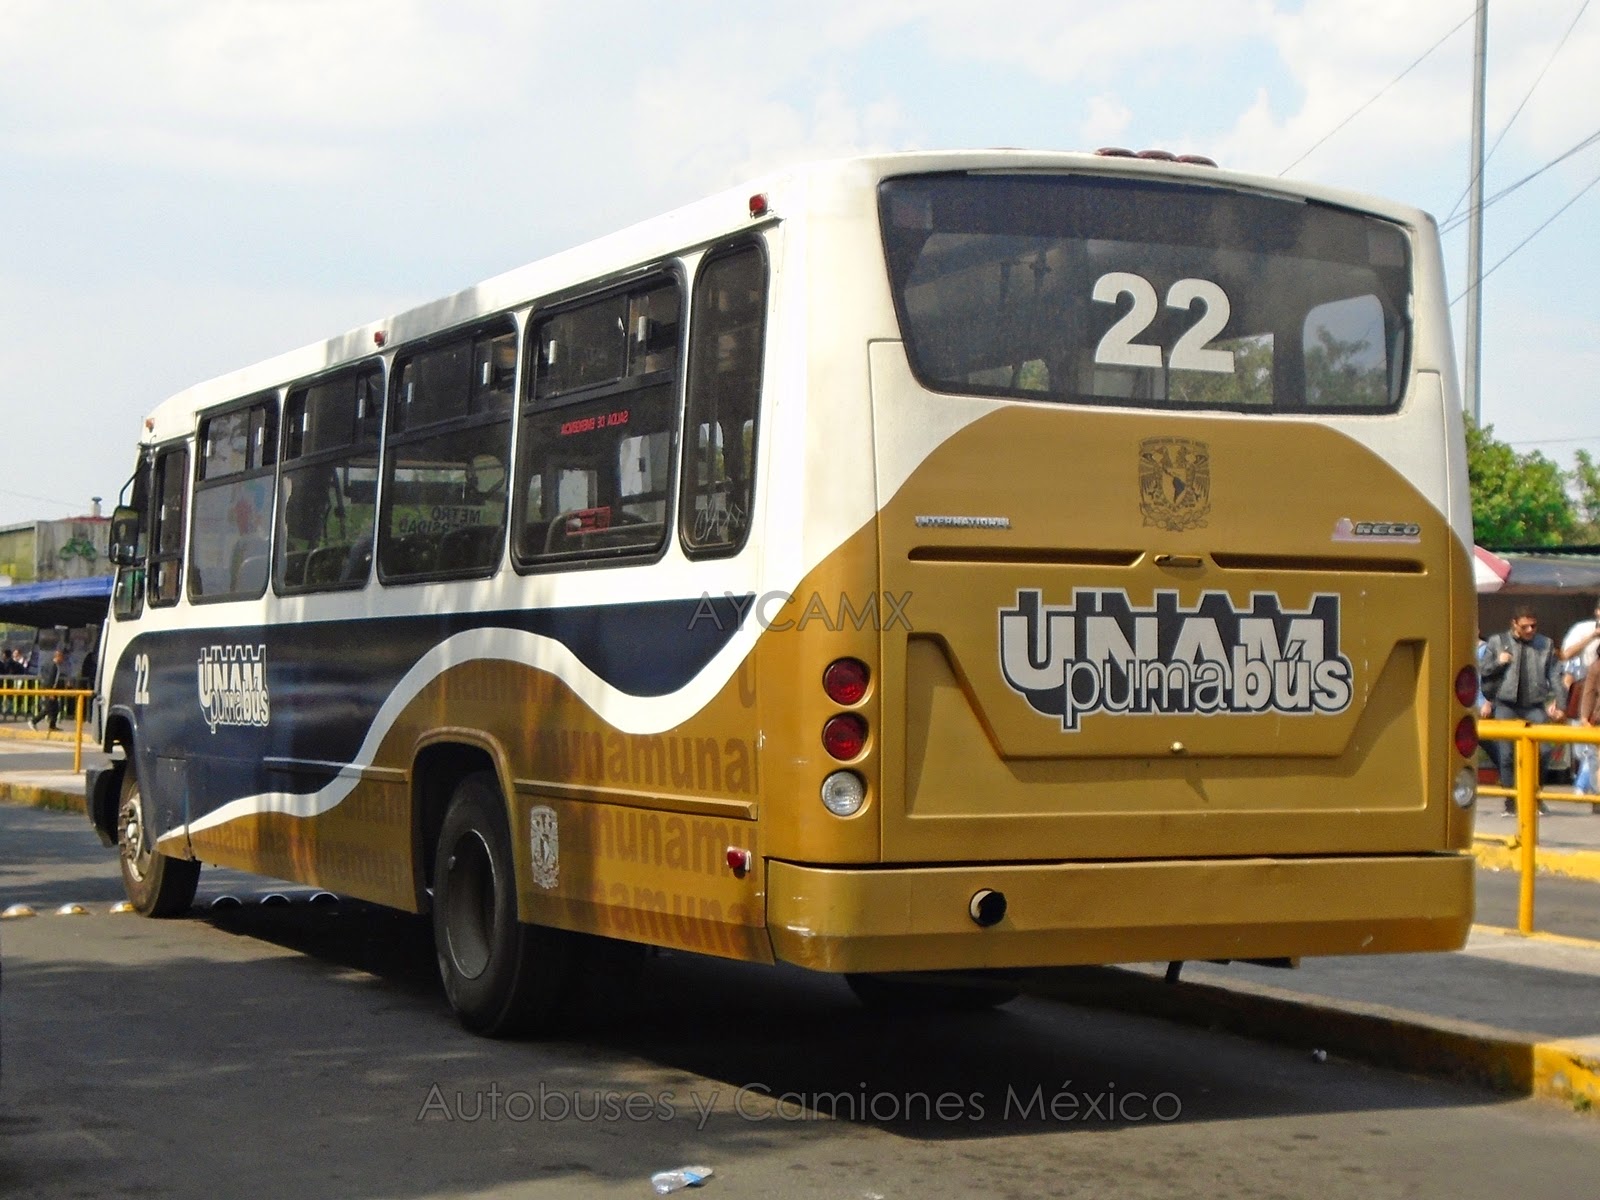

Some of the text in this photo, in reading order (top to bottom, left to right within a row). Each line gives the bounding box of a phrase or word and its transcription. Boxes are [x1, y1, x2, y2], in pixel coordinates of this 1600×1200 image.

[1092, 271, 1235, 373] 22
[134, 653, 150, 705] 22
[198, 646, 266, 708] UNAM
[999, 589, 1336, 692] UNAM
[1065, 639, 1352, 732] pumabús
